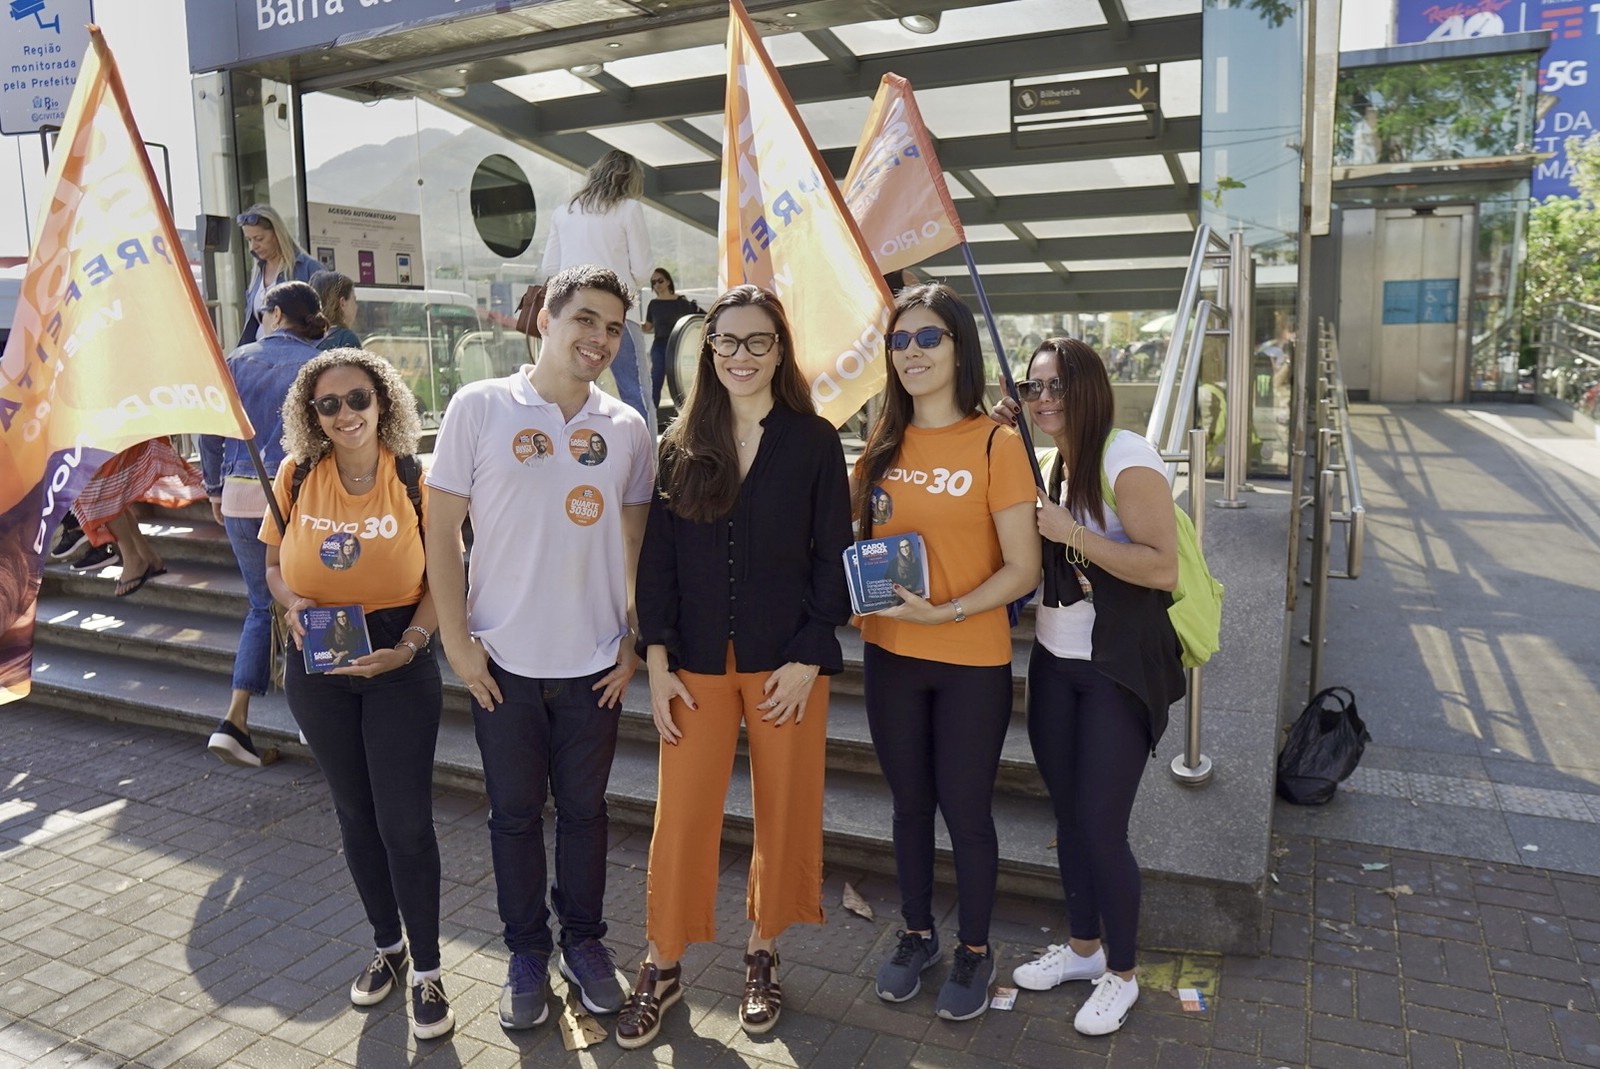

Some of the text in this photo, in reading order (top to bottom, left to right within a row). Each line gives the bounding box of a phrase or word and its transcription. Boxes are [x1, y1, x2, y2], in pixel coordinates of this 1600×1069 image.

[23, 43, 61, 57] Região
[11, 59, 77, 73] monitorada
[1542, 60, 1588, 92] 5G
[3, 75, 77, 92] pela Prefeitu
[1040, 88, 1081, 98] Bilheteria
[44, 97, 59, 110] Rio
[1554, 110, 1593, 133] DA
[328, 207, 397, 221] ACESSO AUTOMATIZADO
[926, 467, 973, 497] 30
[570, 498, 600, 511] DUARTE
[569, 506, 599, 518] 30300
[360, 513, 398, 539] 30
